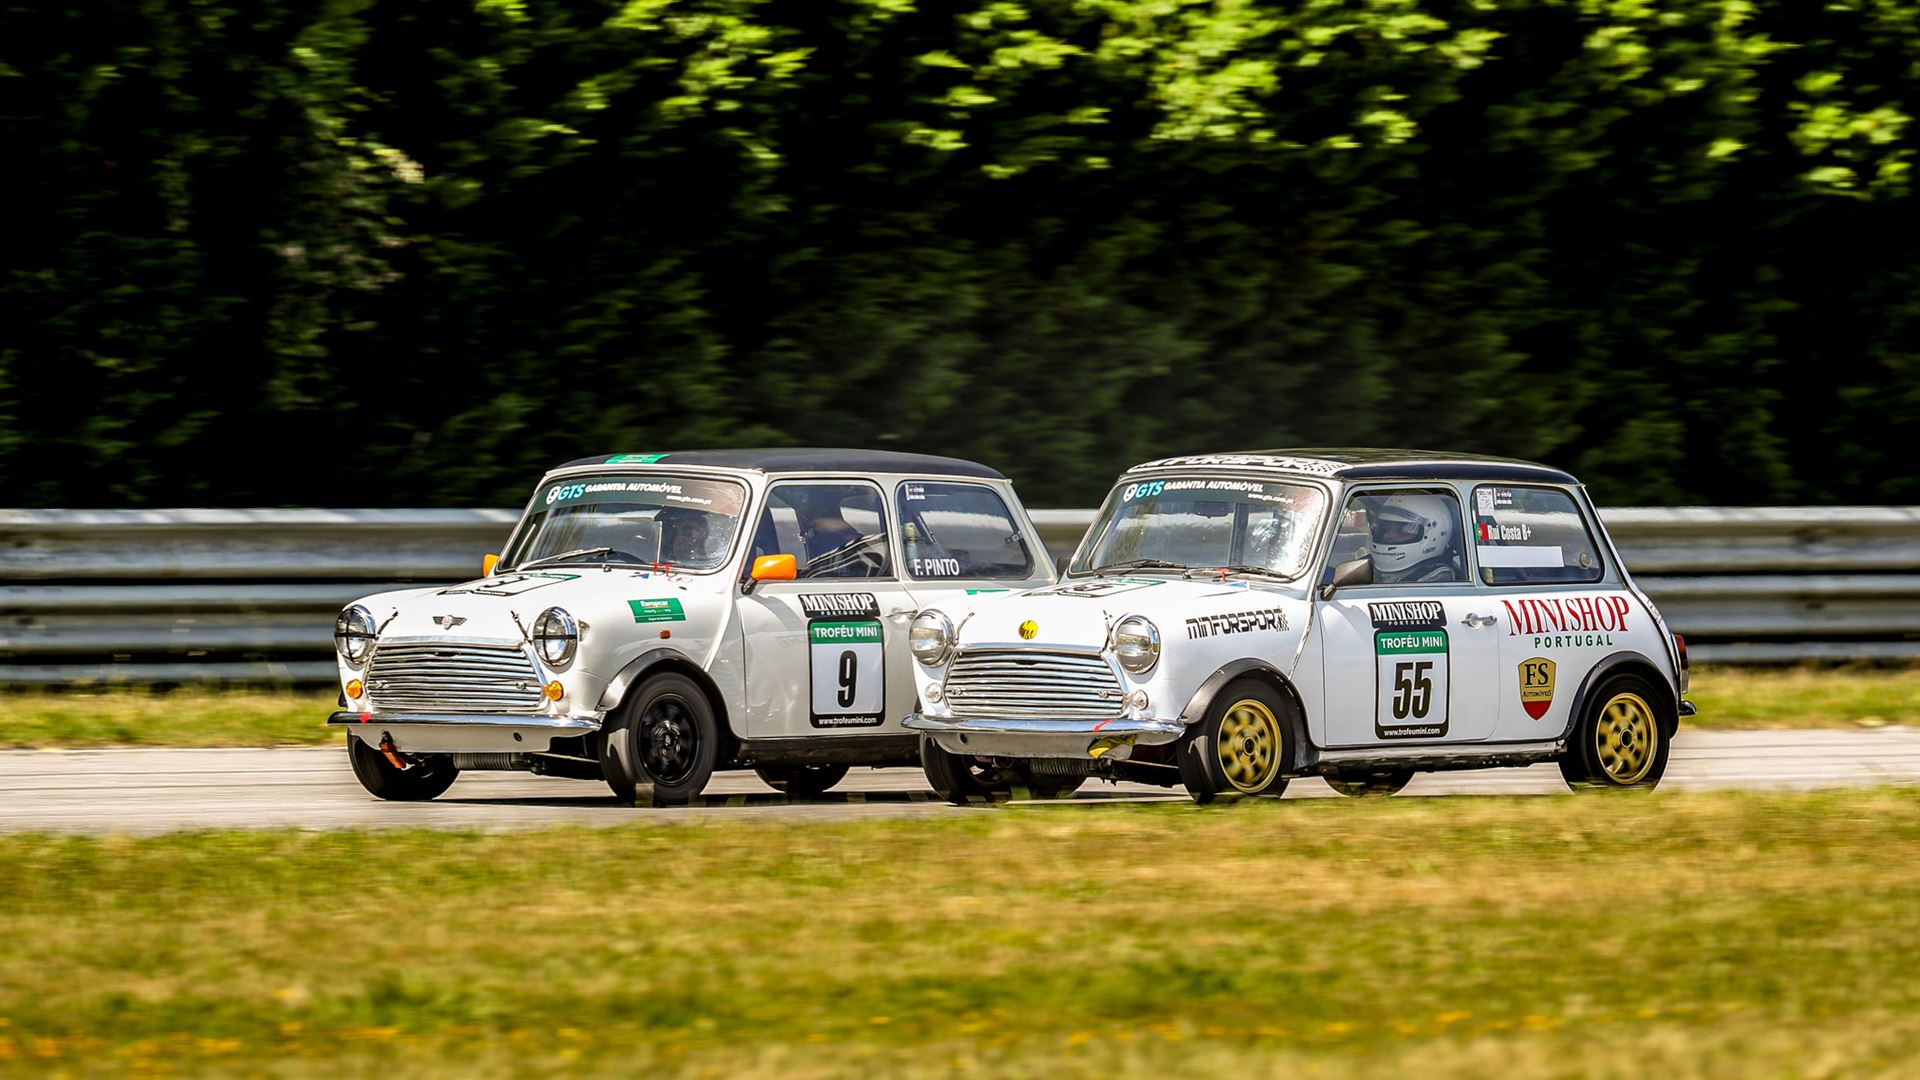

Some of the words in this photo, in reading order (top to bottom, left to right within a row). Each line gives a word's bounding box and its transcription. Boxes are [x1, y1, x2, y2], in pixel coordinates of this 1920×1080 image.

[558, 483, 586, 500] GTS
[585, 482, 627, 493] GARANTIA
[626, 482, 682, 494] AUTOMÓVEL
[1135, 480, 1165, 498] GTS
[1165, 481, 1206, 491] GARANTIA
[1206, 481, 1264, 493] AUTOMÓVEL
[1487, 524, 1500, 540] Rui
[1500, 524, 1522, 540] Costa
[913, 558, 924, 576] F.
[924, 558, 960, 576] PINTO
[800, 593, 875, 612] MINISHOP
[1369, 602, 1442, 621] MINISHOP
[1501, 596, 1630, 636] MINISHOP
[814, 625, 854, 639] TROFÉU
[855, 626, 878, 638] MINI
[1534, 634, 1613, 648] PORTUGAL
[1380, 634, 1420, 649] TROFÉU
[1422, 636, 1443, 648] MINI
[838, 650, 857, 708] 9
[1524, 662, 1549, 686] FS
[1393, 661, 1433, 719] 55
[819, 717, 877, 725] www.trofeumini.com
[1383, 727, 1440, 736] www.trofeumini.com
